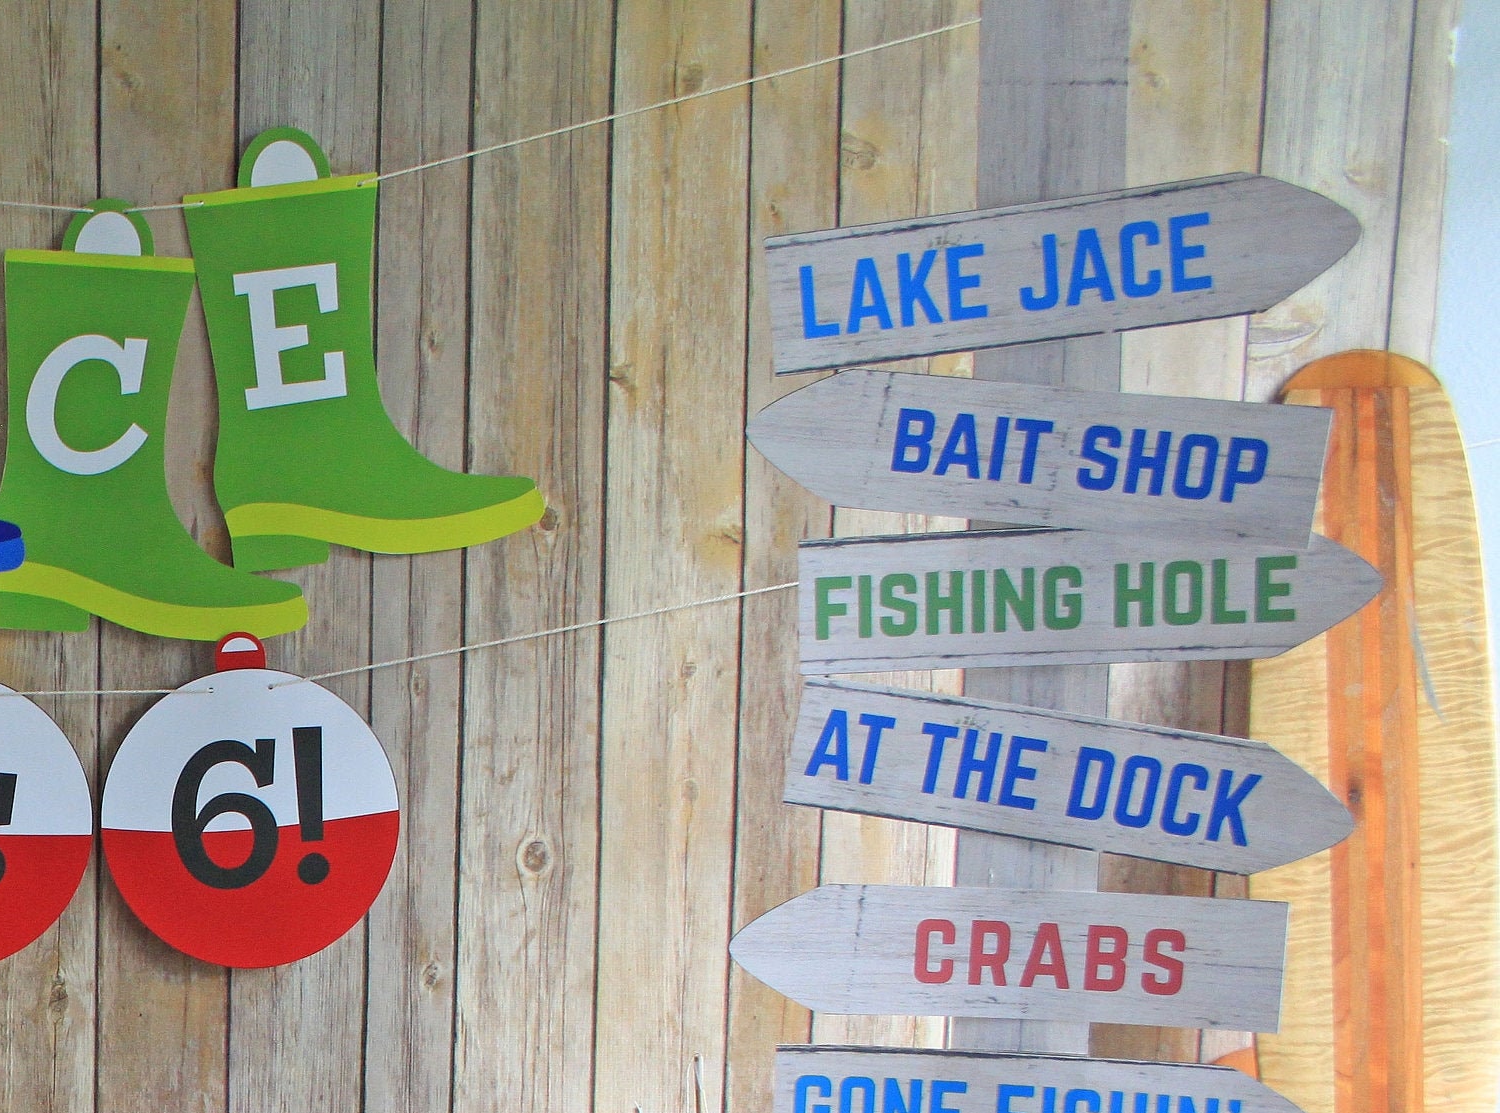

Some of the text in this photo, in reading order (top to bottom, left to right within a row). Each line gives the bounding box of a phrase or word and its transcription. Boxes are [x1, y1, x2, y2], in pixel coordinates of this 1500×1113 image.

[799, 212, 1213, 340] LAKE JACE
[890, 407, 1269, 504] BAIT SHOP
[814, 555, 1298, 640] FISHING HOLE
[171, 726, 330, 890] 6!
[803, 709, 1263, 847] AT THE DOCK
[913, 918, 1187, 995] CRABS
